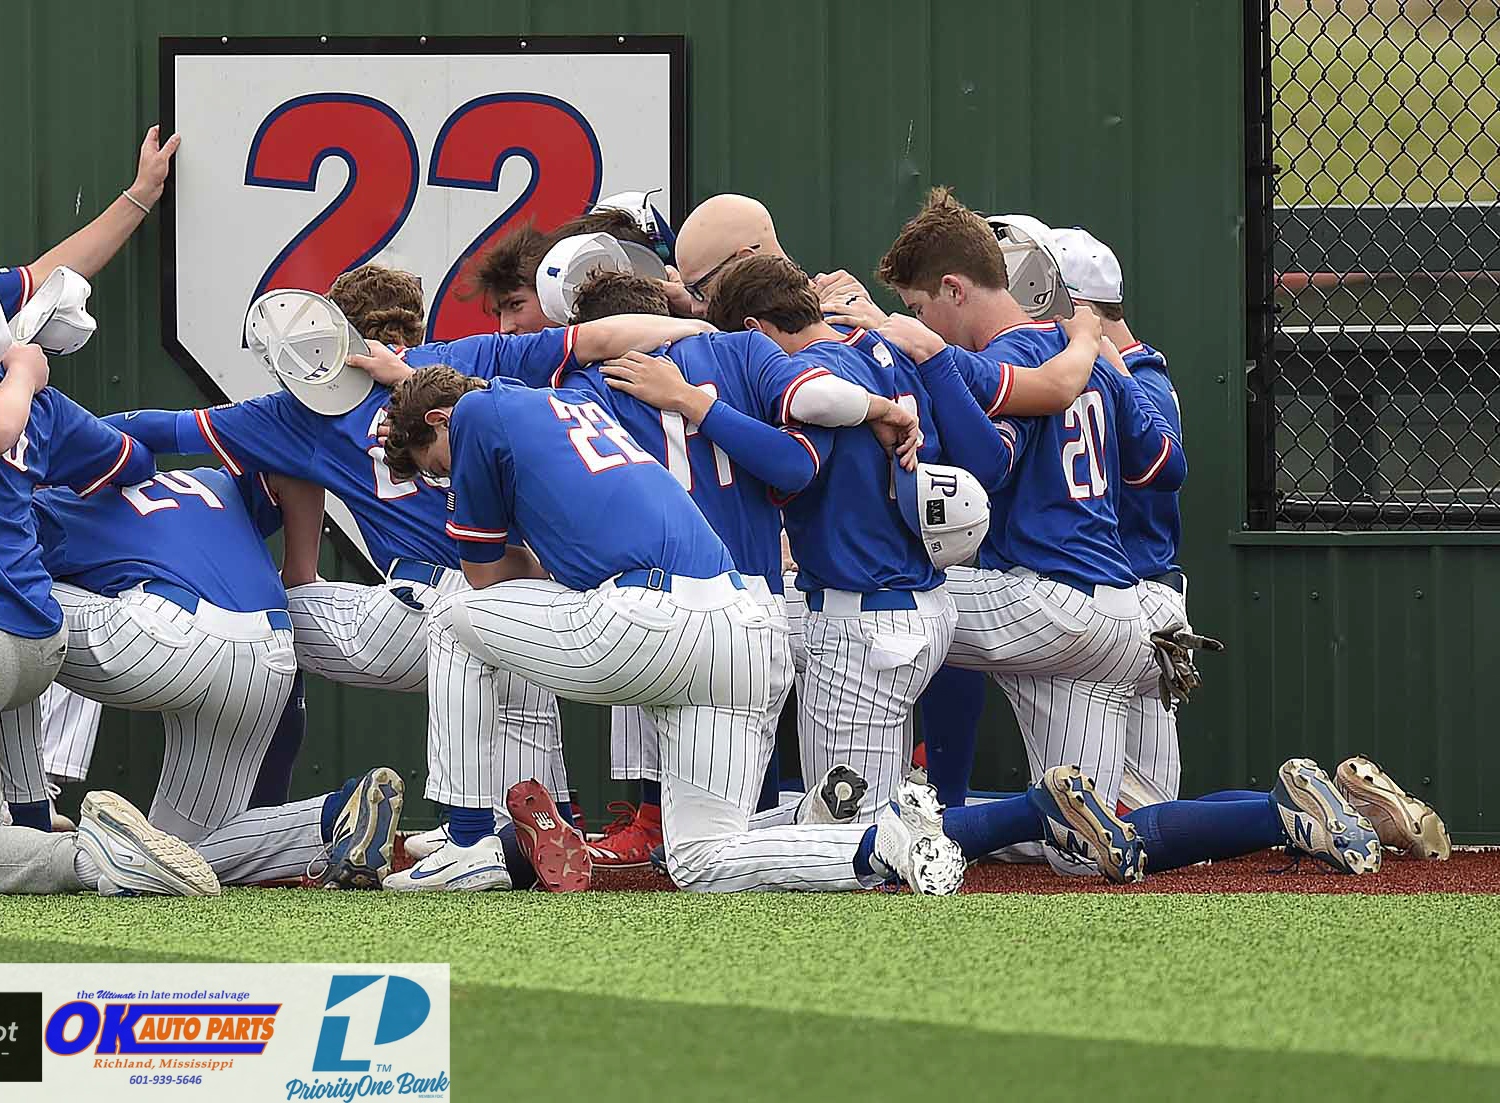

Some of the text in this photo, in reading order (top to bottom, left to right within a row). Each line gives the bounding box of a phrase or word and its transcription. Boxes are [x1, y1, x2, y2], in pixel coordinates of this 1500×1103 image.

[242, 91, 603, 350] 22
[548, 395, 660, 474] 22
[1061, 389, 1107, 500] 20
[121, 469, 225, 516] 24
[925, 470, 958, 498] JP
